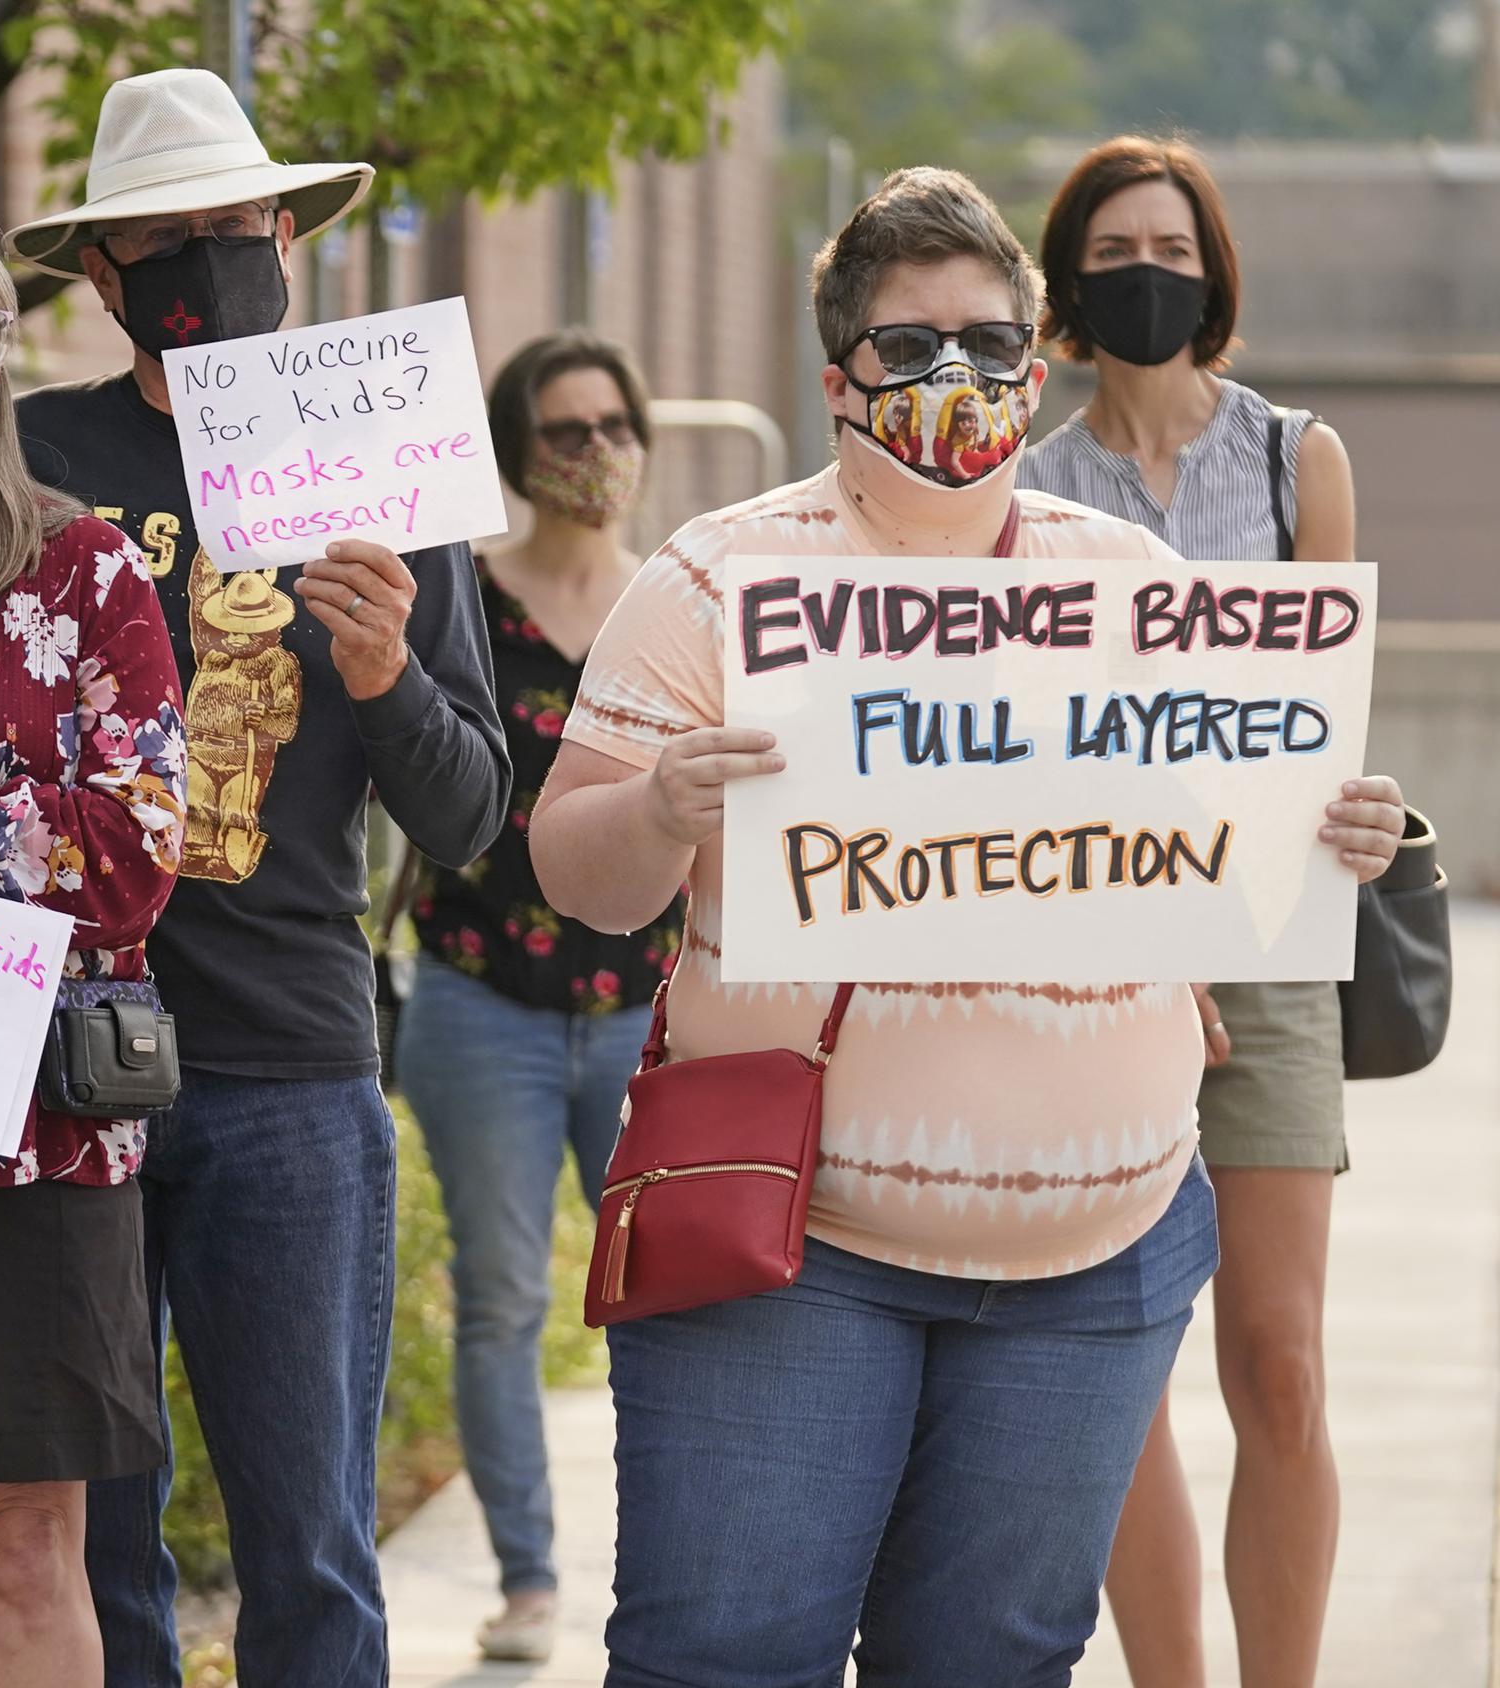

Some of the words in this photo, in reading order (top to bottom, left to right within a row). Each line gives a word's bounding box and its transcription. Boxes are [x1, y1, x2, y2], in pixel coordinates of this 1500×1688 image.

[184, 355, 236, 394] No
[199, 406, 261, 445] for
[293, 365, 428, 423] kids?
[200, 448, 364, 506] Masks
[395, 432, 478, 467] are
[221, 488, 420, 552] necessary
[741, 577, 1096, 675] EVIDENCE
[1132, 579, 1363, 654] BASED
[852, 688, 1032, 775] FULL
[1066, 689, 1331, 766] LAYERED
[782, 820, 1234, 927] PROTECTION
